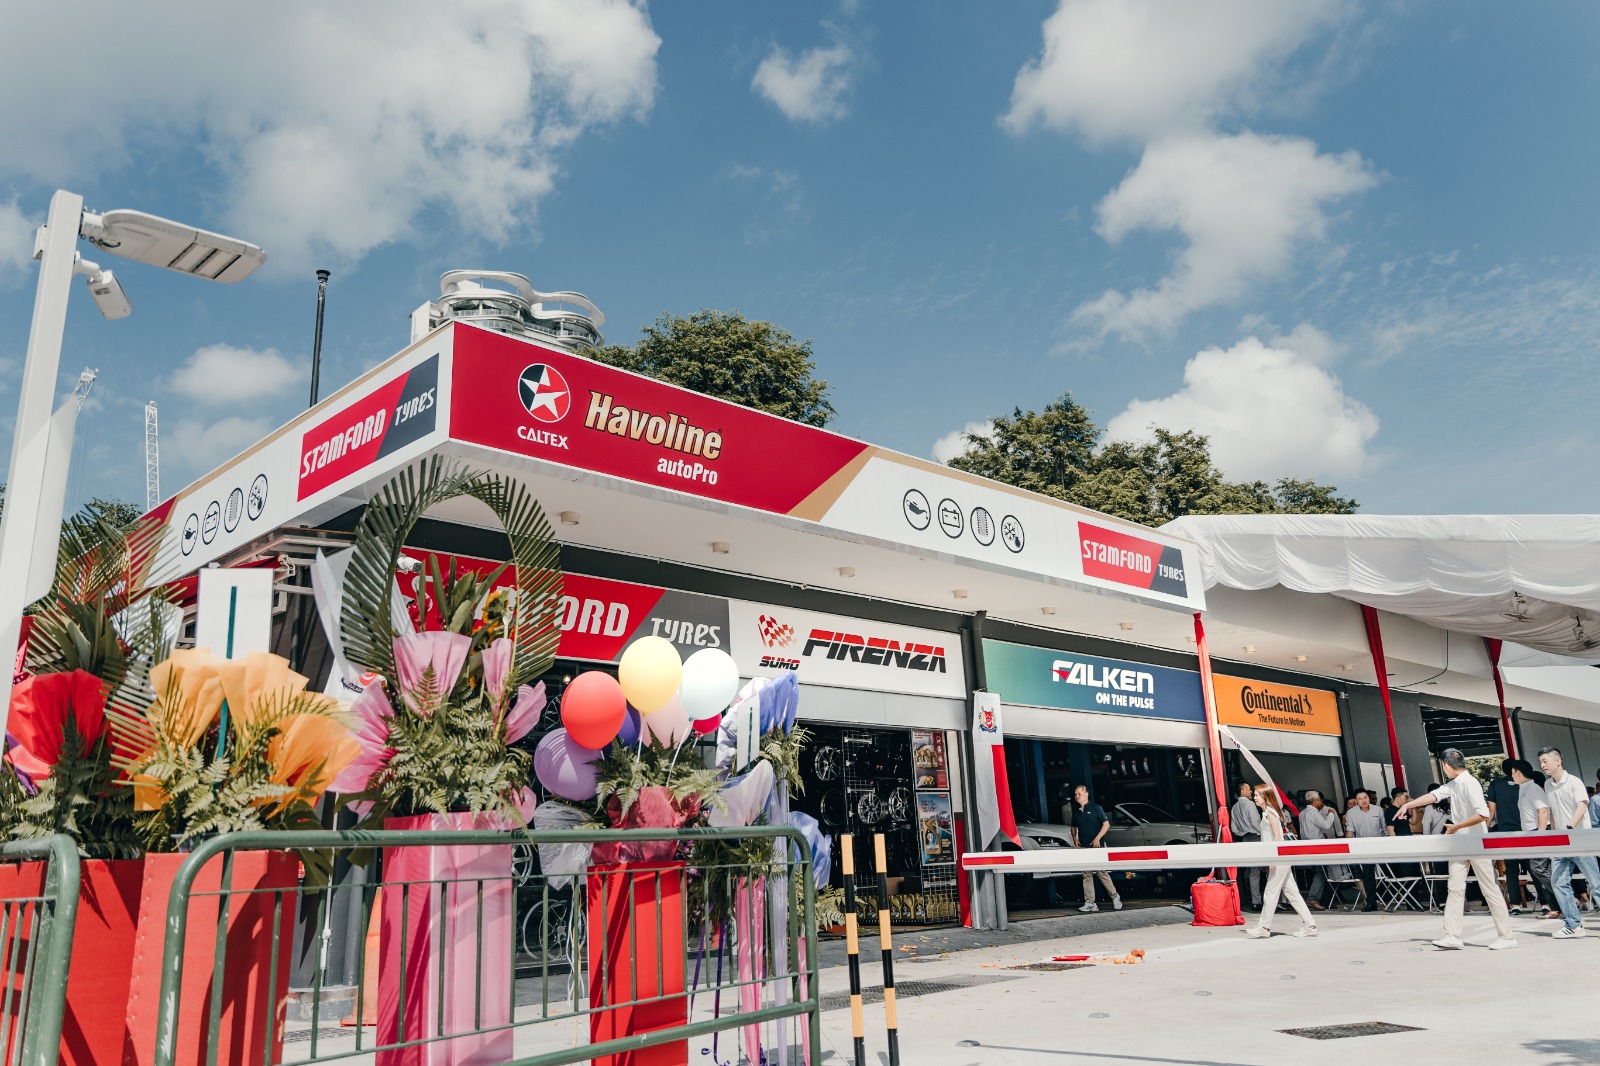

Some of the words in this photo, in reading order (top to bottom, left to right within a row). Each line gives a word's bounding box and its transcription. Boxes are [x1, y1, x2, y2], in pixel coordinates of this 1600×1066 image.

[516, 425, 569, 450] CALTEX
[584, 389, 723, 461] Havoline
[656, 457, 718, 485] autoPro
[759, 655, 801, 671] SUMO
[801, 628, 947, 674] FIRENZA
[1051, 659, 1154, 694] FALKEN
[1095, 692, 1110, 705] ON
[1111, 694, 1128, 707] THE
[1128, 696, 1154, 709] PULSE
[1241, 685, 1304, 714] Continental
[1258, 714, 1268, 723] The
[1268, 715, 1283, 725] Future
[1289, 718, 1305, 727] Motion
